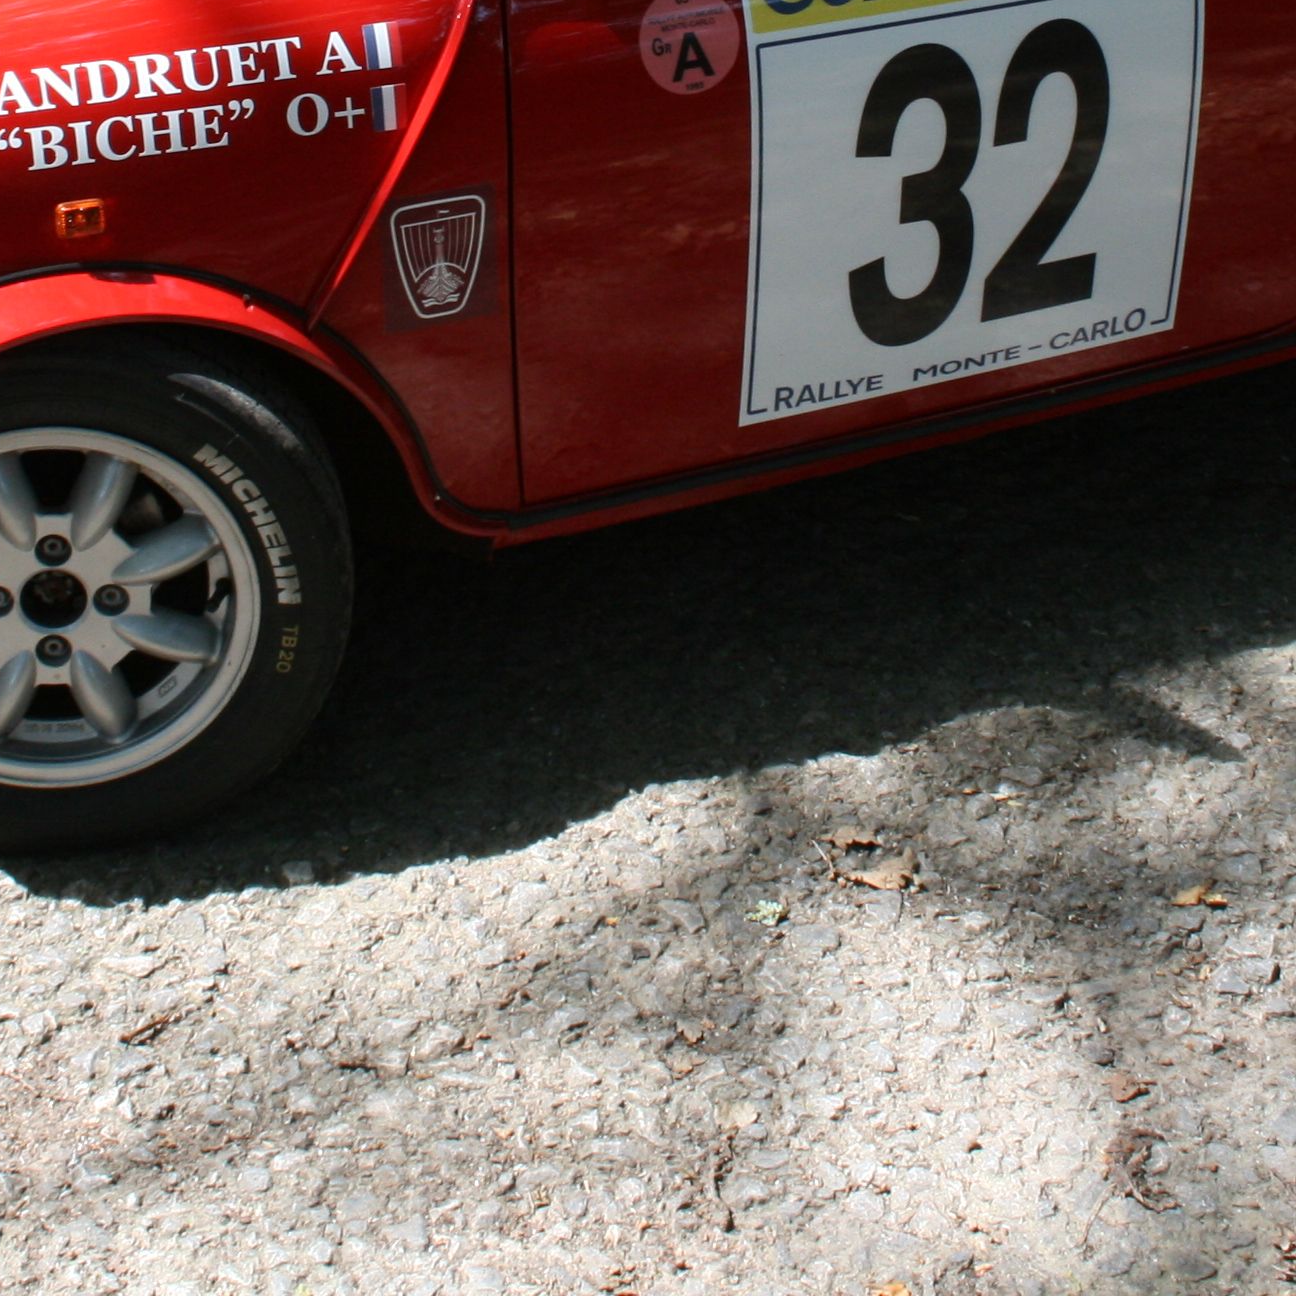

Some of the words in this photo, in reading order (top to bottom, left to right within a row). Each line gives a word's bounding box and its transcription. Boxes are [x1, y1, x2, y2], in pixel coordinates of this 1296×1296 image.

[316, 30, 363, 77] A
[671, 31, 717, 83] A
[847, 17, 1111, 348] 32
[772, 374, 885, 412] RALLYE
[192, 443, 303, 605] MICHELIN
